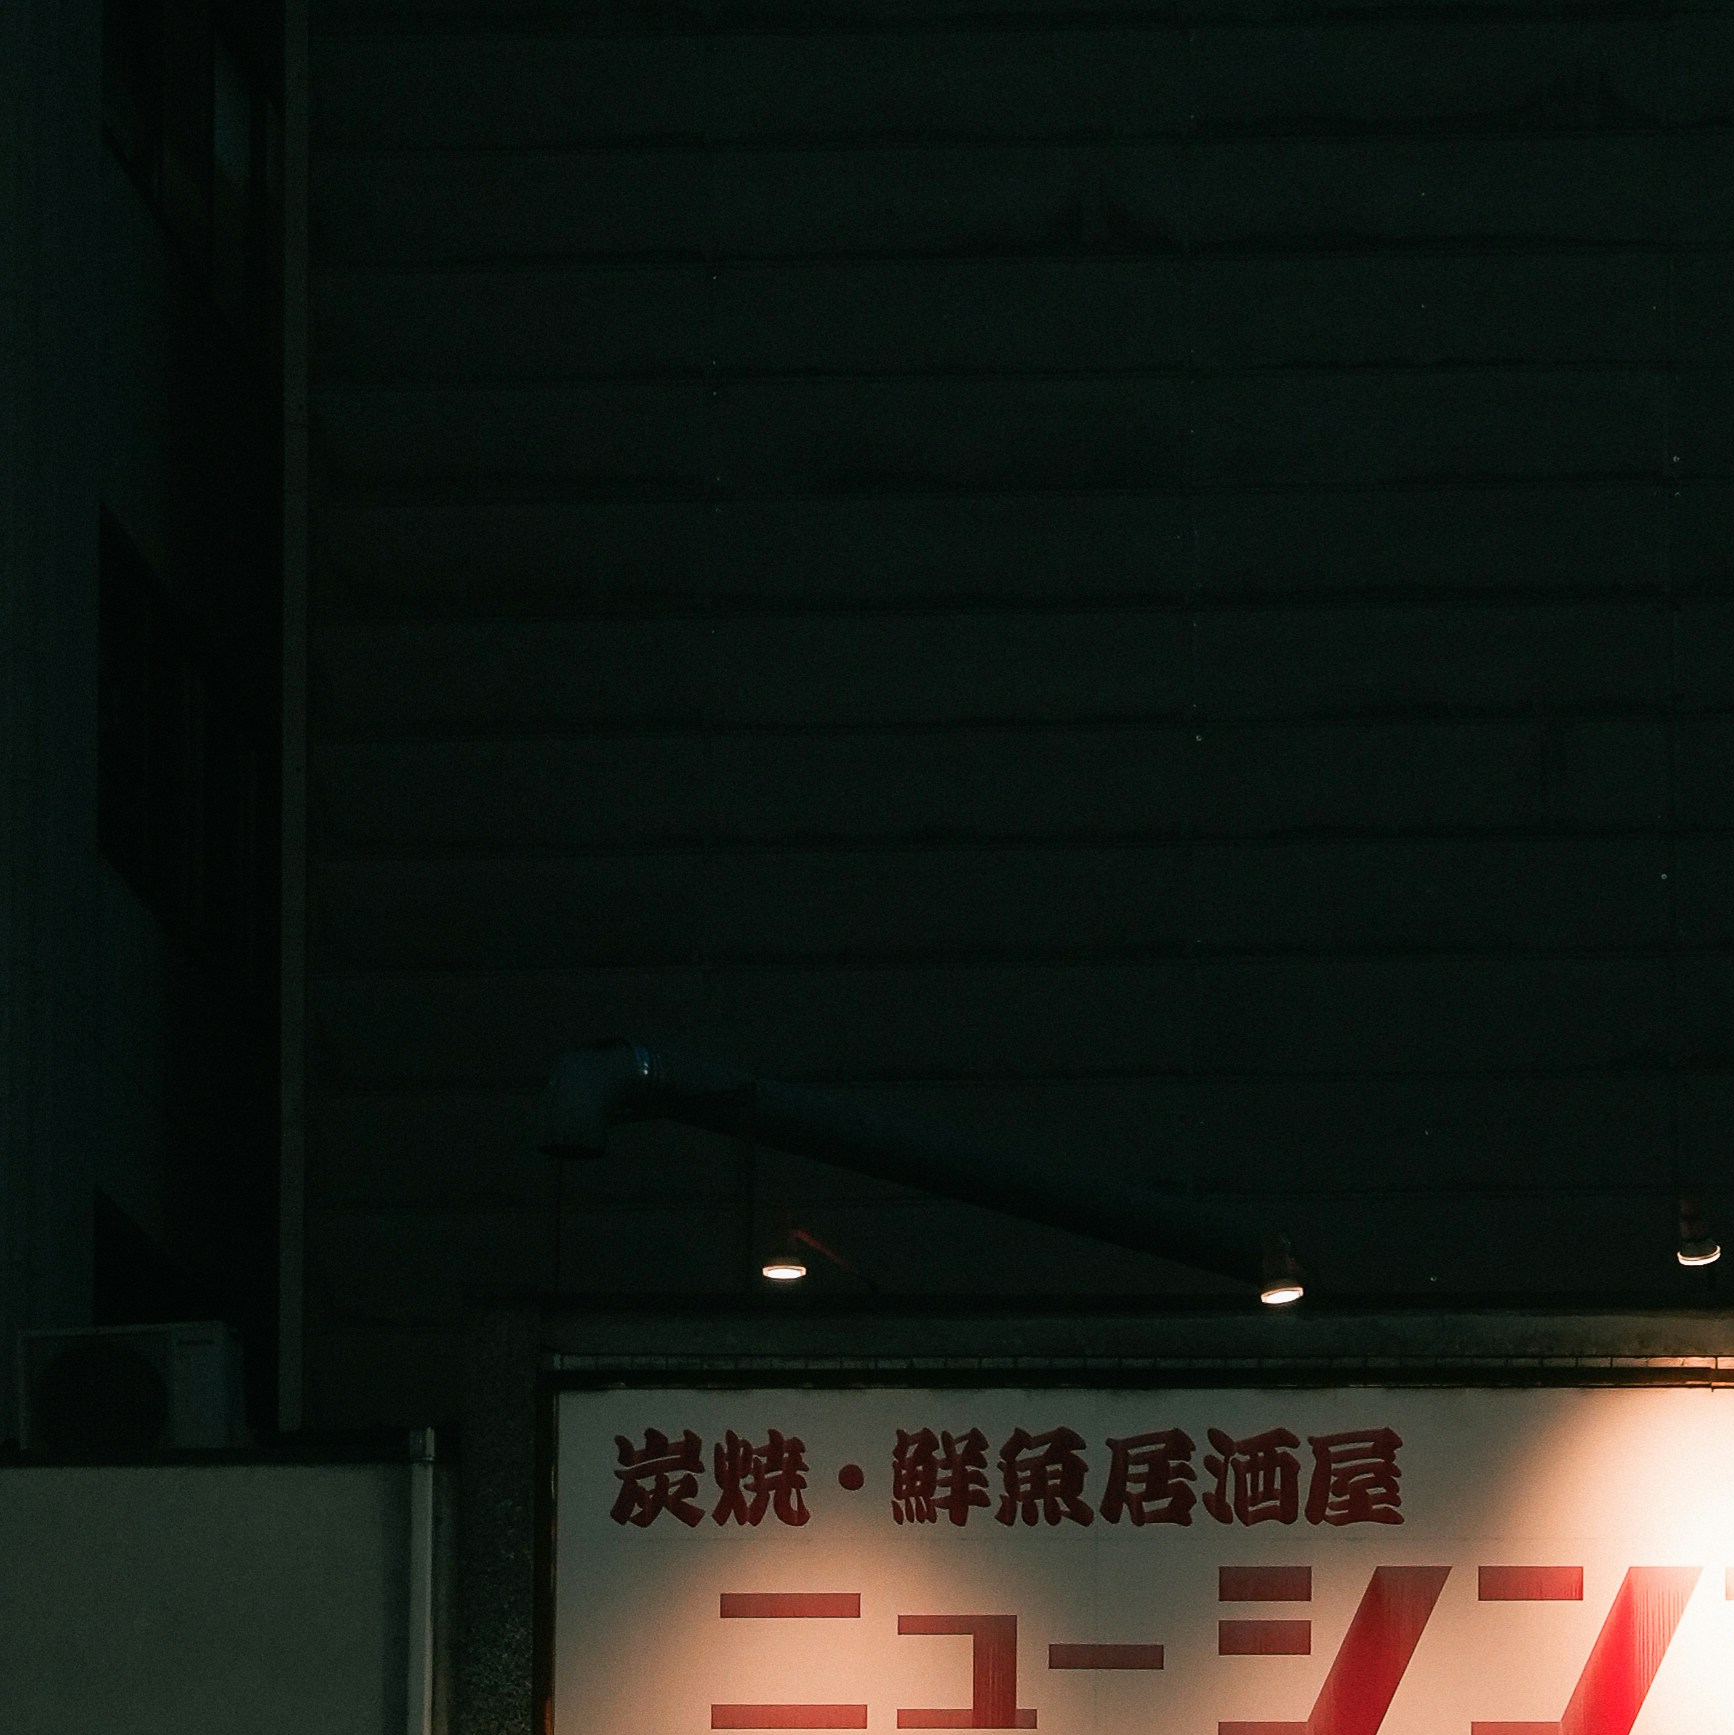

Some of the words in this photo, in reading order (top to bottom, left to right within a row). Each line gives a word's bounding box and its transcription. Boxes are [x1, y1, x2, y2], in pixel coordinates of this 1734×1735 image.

[608, 1425, 1406, 1528] 炭焼・鮮魚居酒屋
